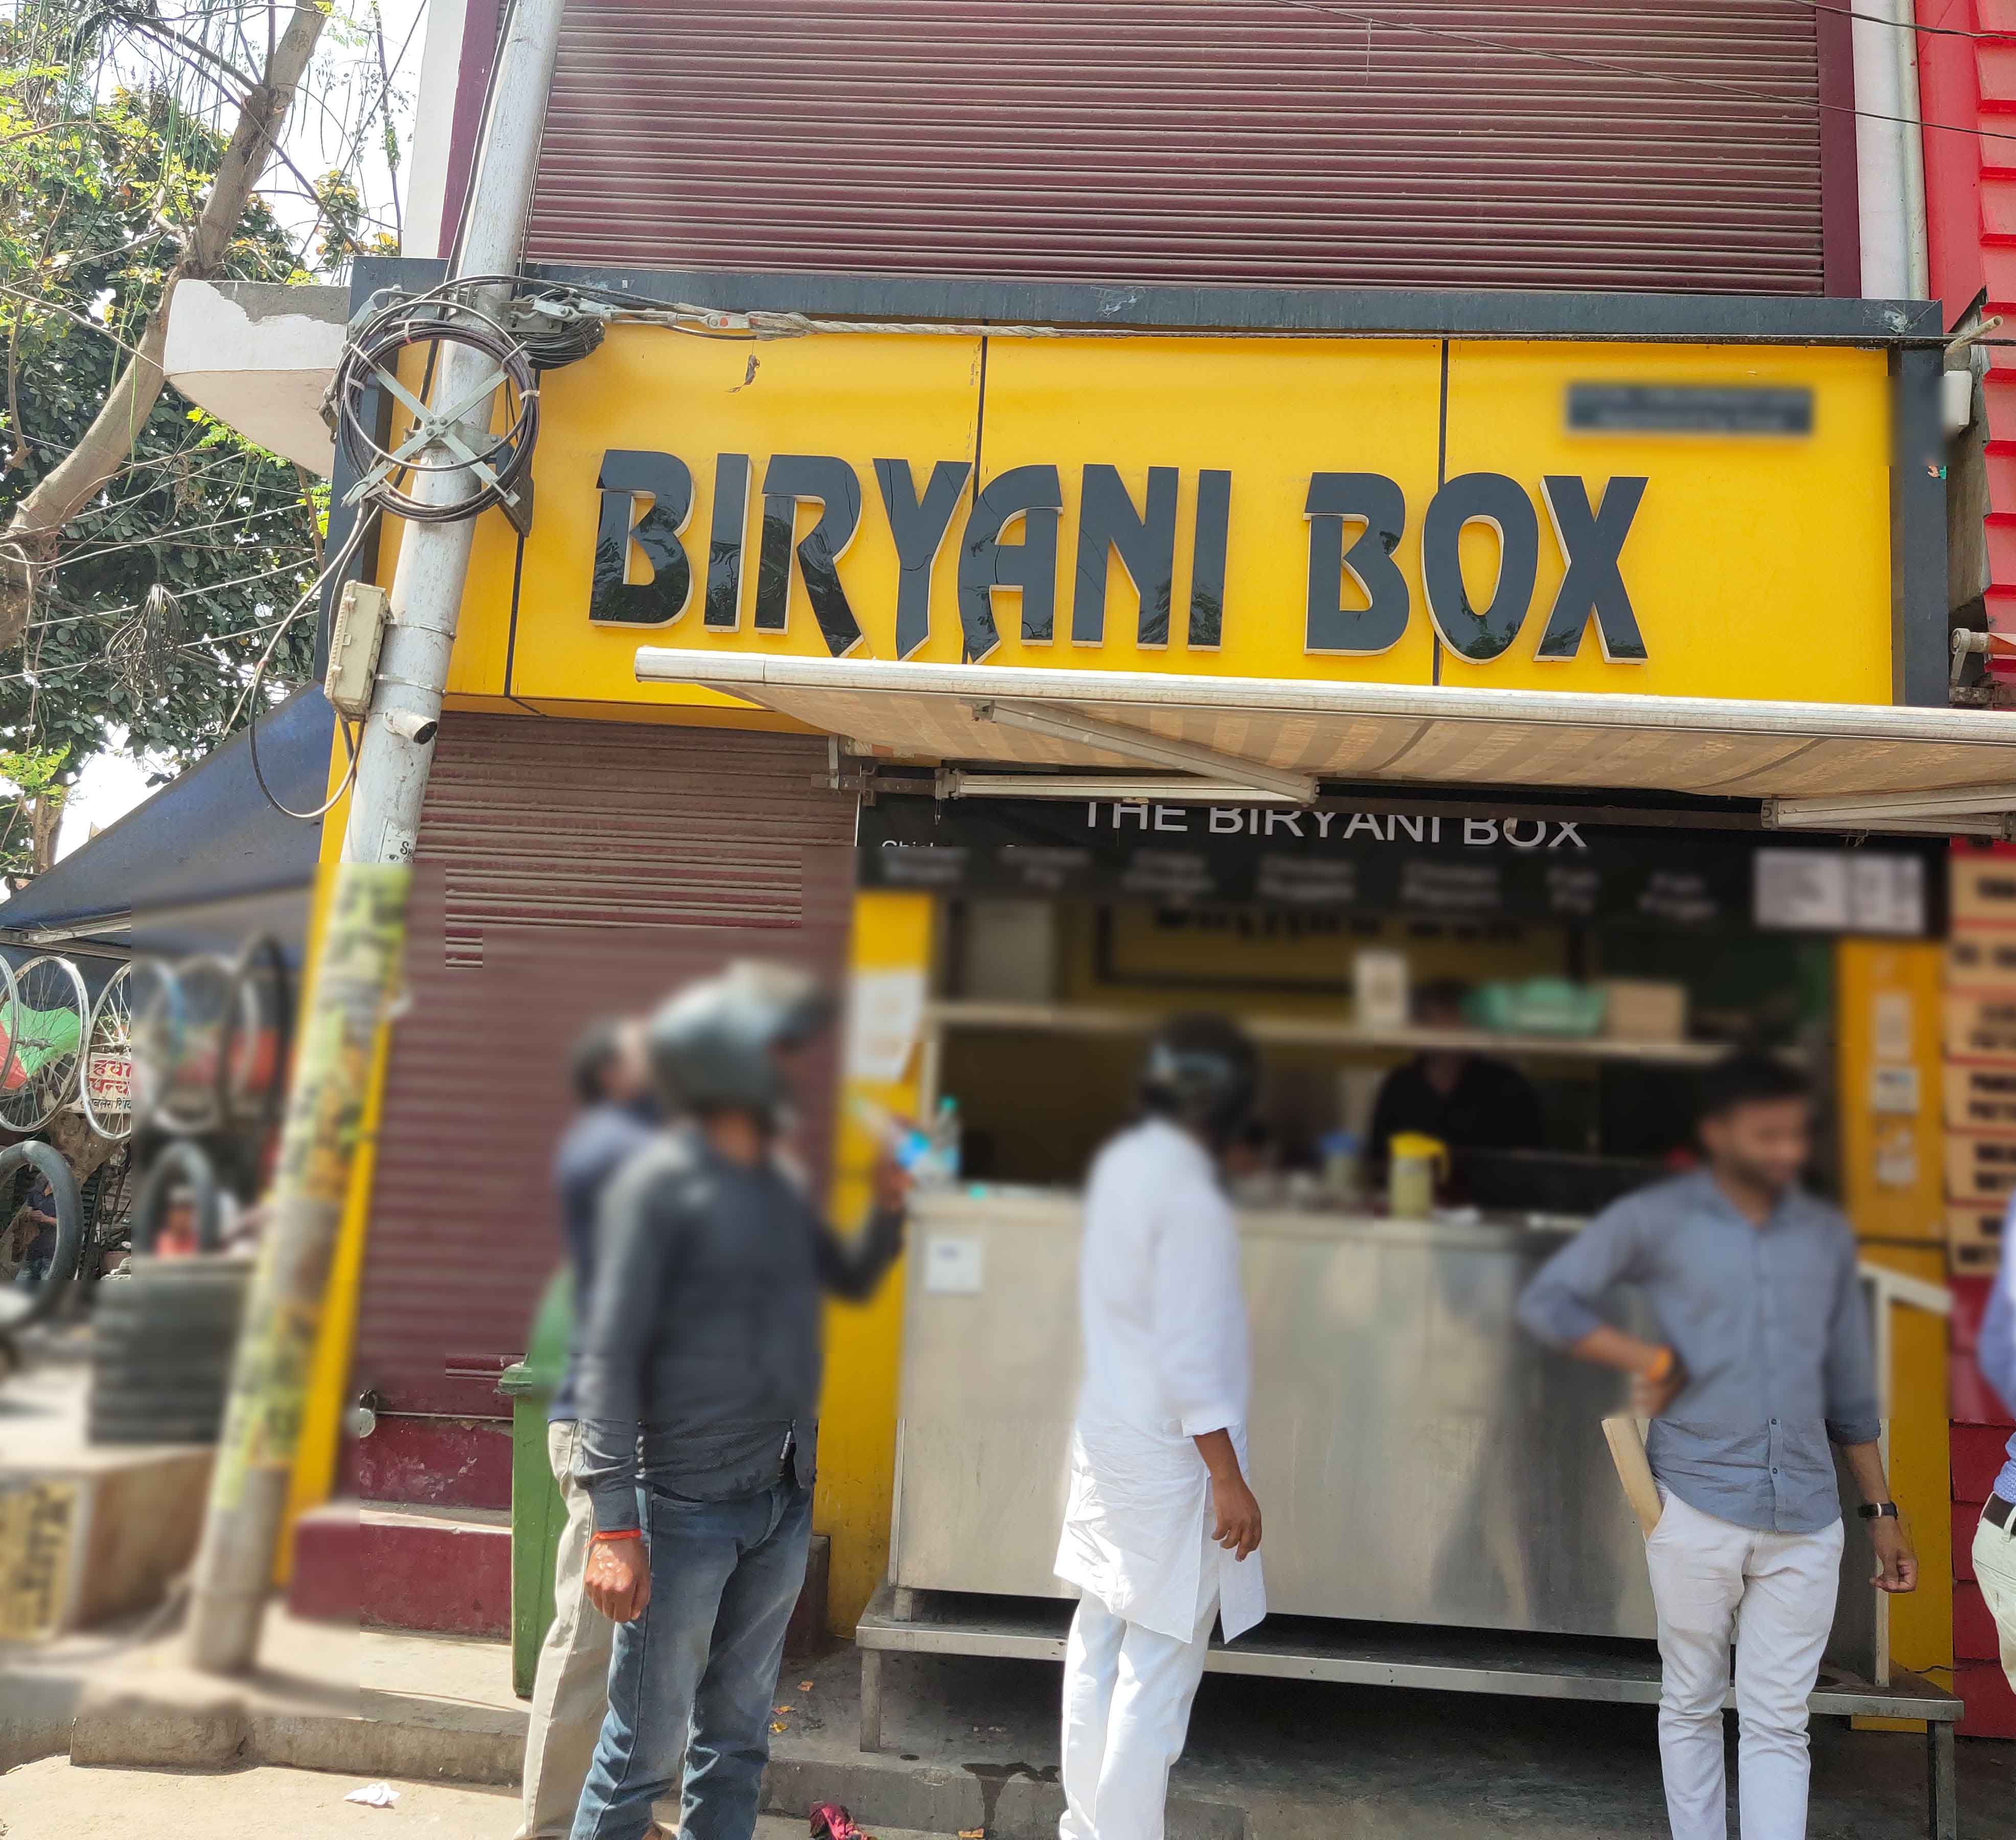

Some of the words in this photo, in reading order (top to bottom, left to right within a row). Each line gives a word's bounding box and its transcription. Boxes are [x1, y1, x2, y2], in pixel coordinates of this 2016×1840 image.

[588, 449, 1232, 664] BIRYANI
[1302, 471, 1650, 665] BOX
[1209, 807, 1440, 843] BIRYANI
[1463, 817, 1587, 847] BOX
